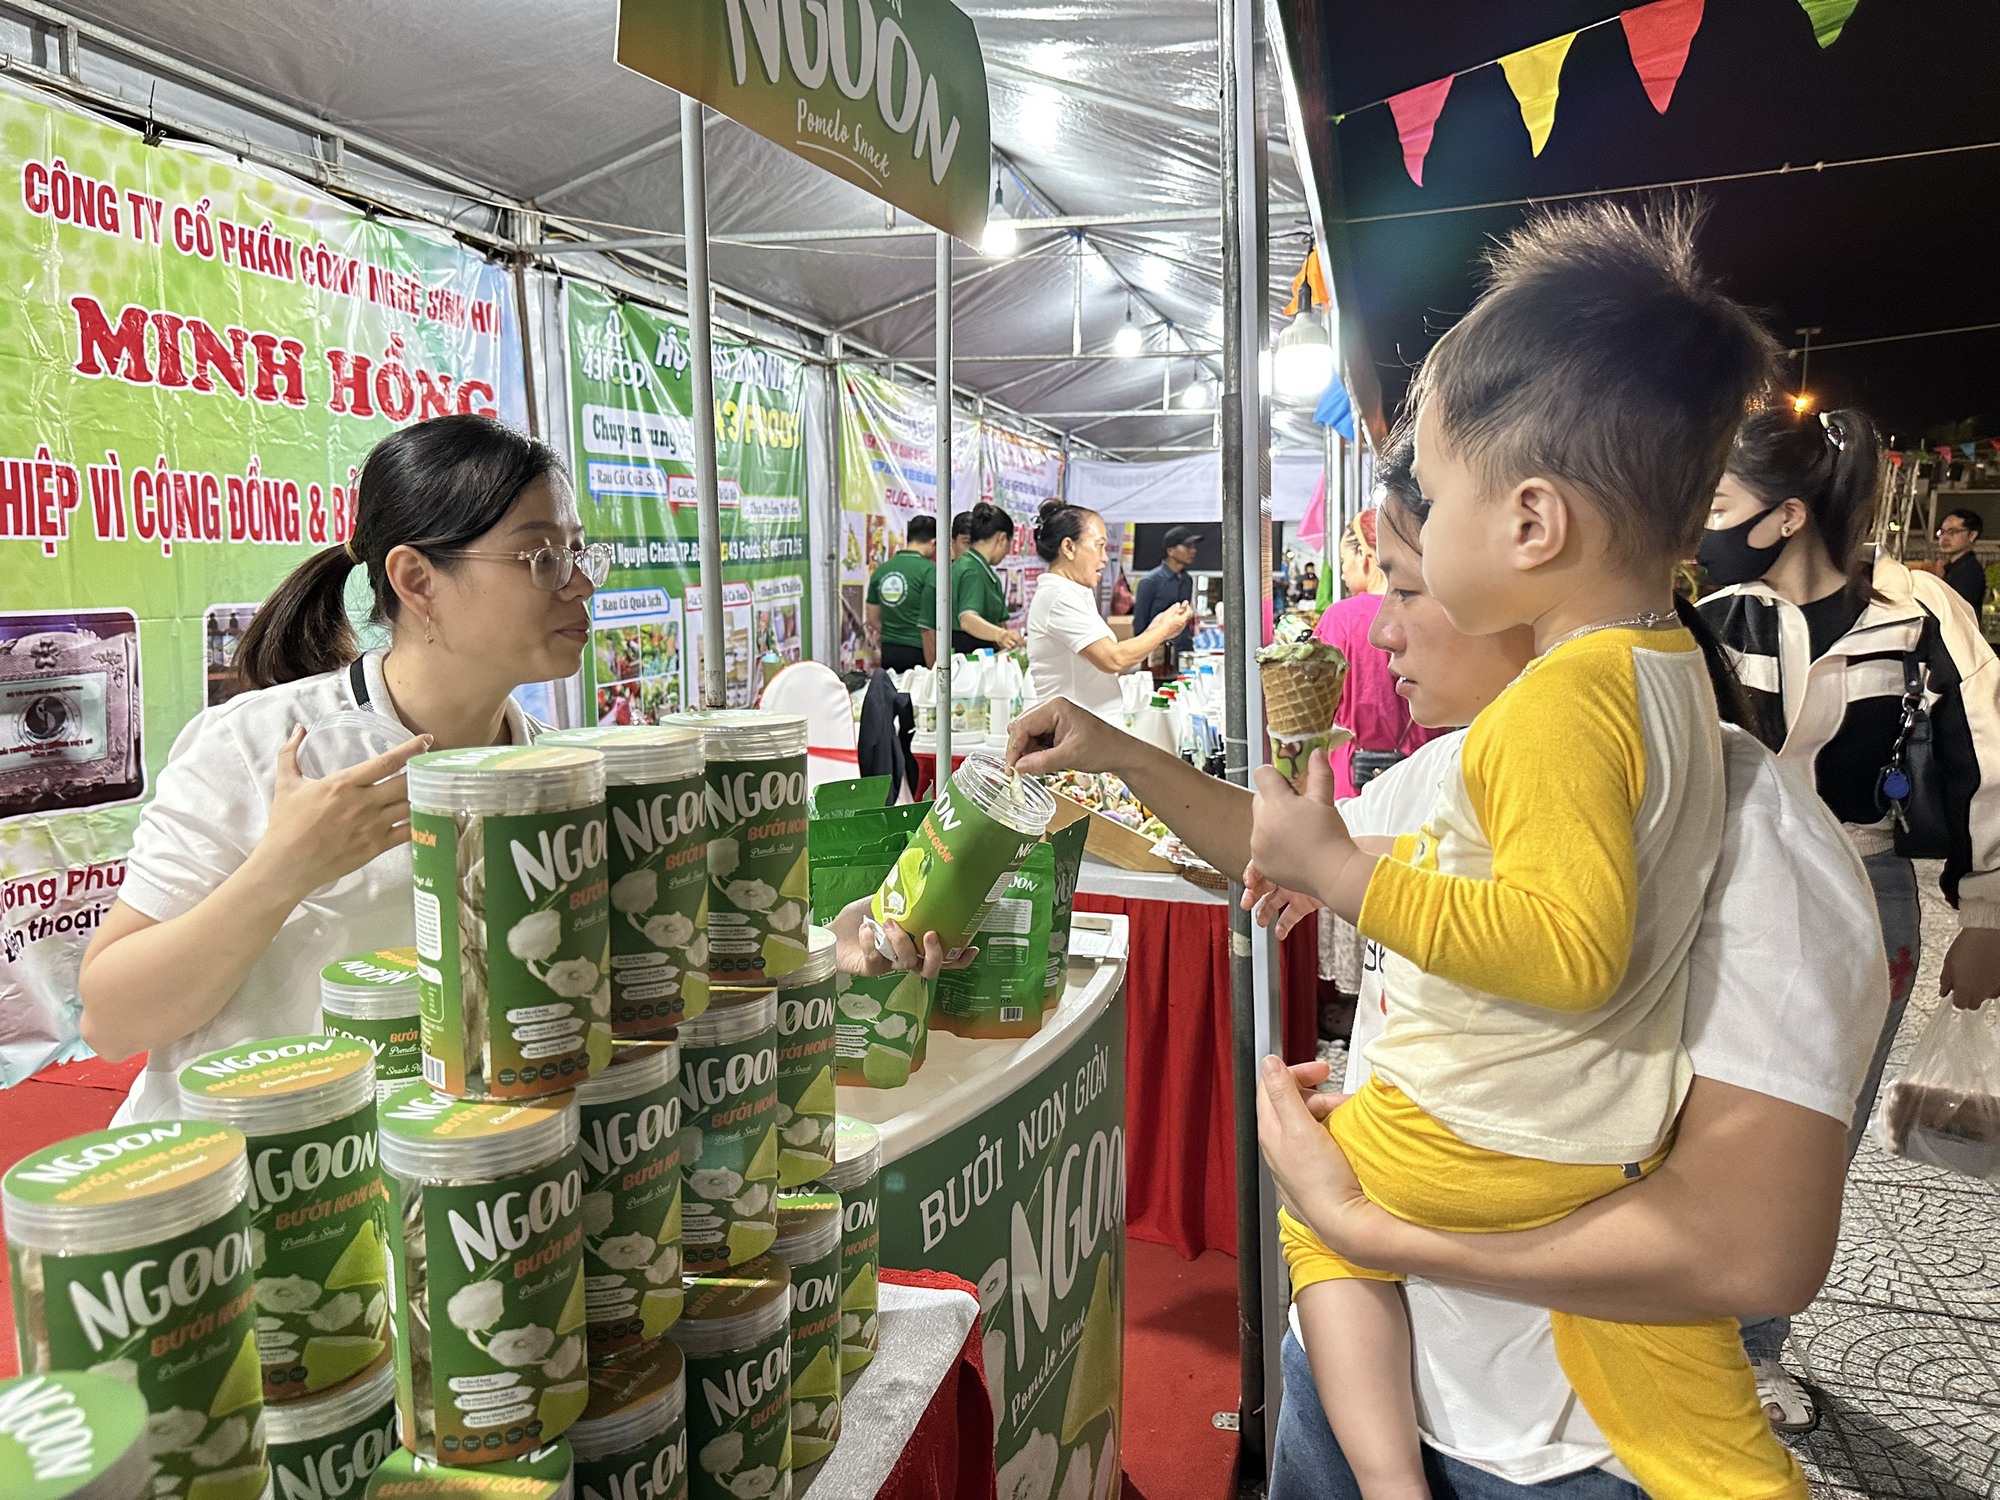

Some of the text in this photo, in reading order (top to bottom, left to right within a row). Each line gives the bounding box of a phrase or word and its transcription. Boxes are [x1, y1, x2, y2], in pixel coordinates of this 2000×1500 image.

[797, 99, 891, 178] Pomelo Snack
[23, 158, 120, 235] CÔNG
[127, 190, 163, 243] TY
[174, 198, 214, 259] CỔ
[222, 218, 294, 280] PHẦN
[300, 236, 361, 297] CÔNG
[369, 265, 423, 326] NGHỆ
[70, 296, 498, 421] MINH HỒNG
[89, 449, 126, 539] VÌ
[133, 456, 221, 556] CỘNG
[227, 455, 302, 544] ĐỒNG
[308, 491, 328, 543] &
[747, 818, 785, 842] BƯỞI
[66, 859, 126, 896] Phú
[191, 1039, 334, 1078] NGOON
[206, 1072, 261, 1092] BƯỞI
[262, 1060, 307, 1077] NON
[712, 1101, 752, 1128] BƯỞI
[16, 1122, 182, 1184] NGOON
[920, 1044, 1109, 1254] BƯỞI NON GIÒN
[56, 1171, 118, 1201] BƯỞI
[623, 1156, 664, 1191] BƯỞI
[275, 1197, 332, 1231] BƯỞI
[334, 1187, 369, 1214] NON
[150, 1312, 215, 1358] BƯỞI
[1012, 1347, 1057, 1428] Pomelo
